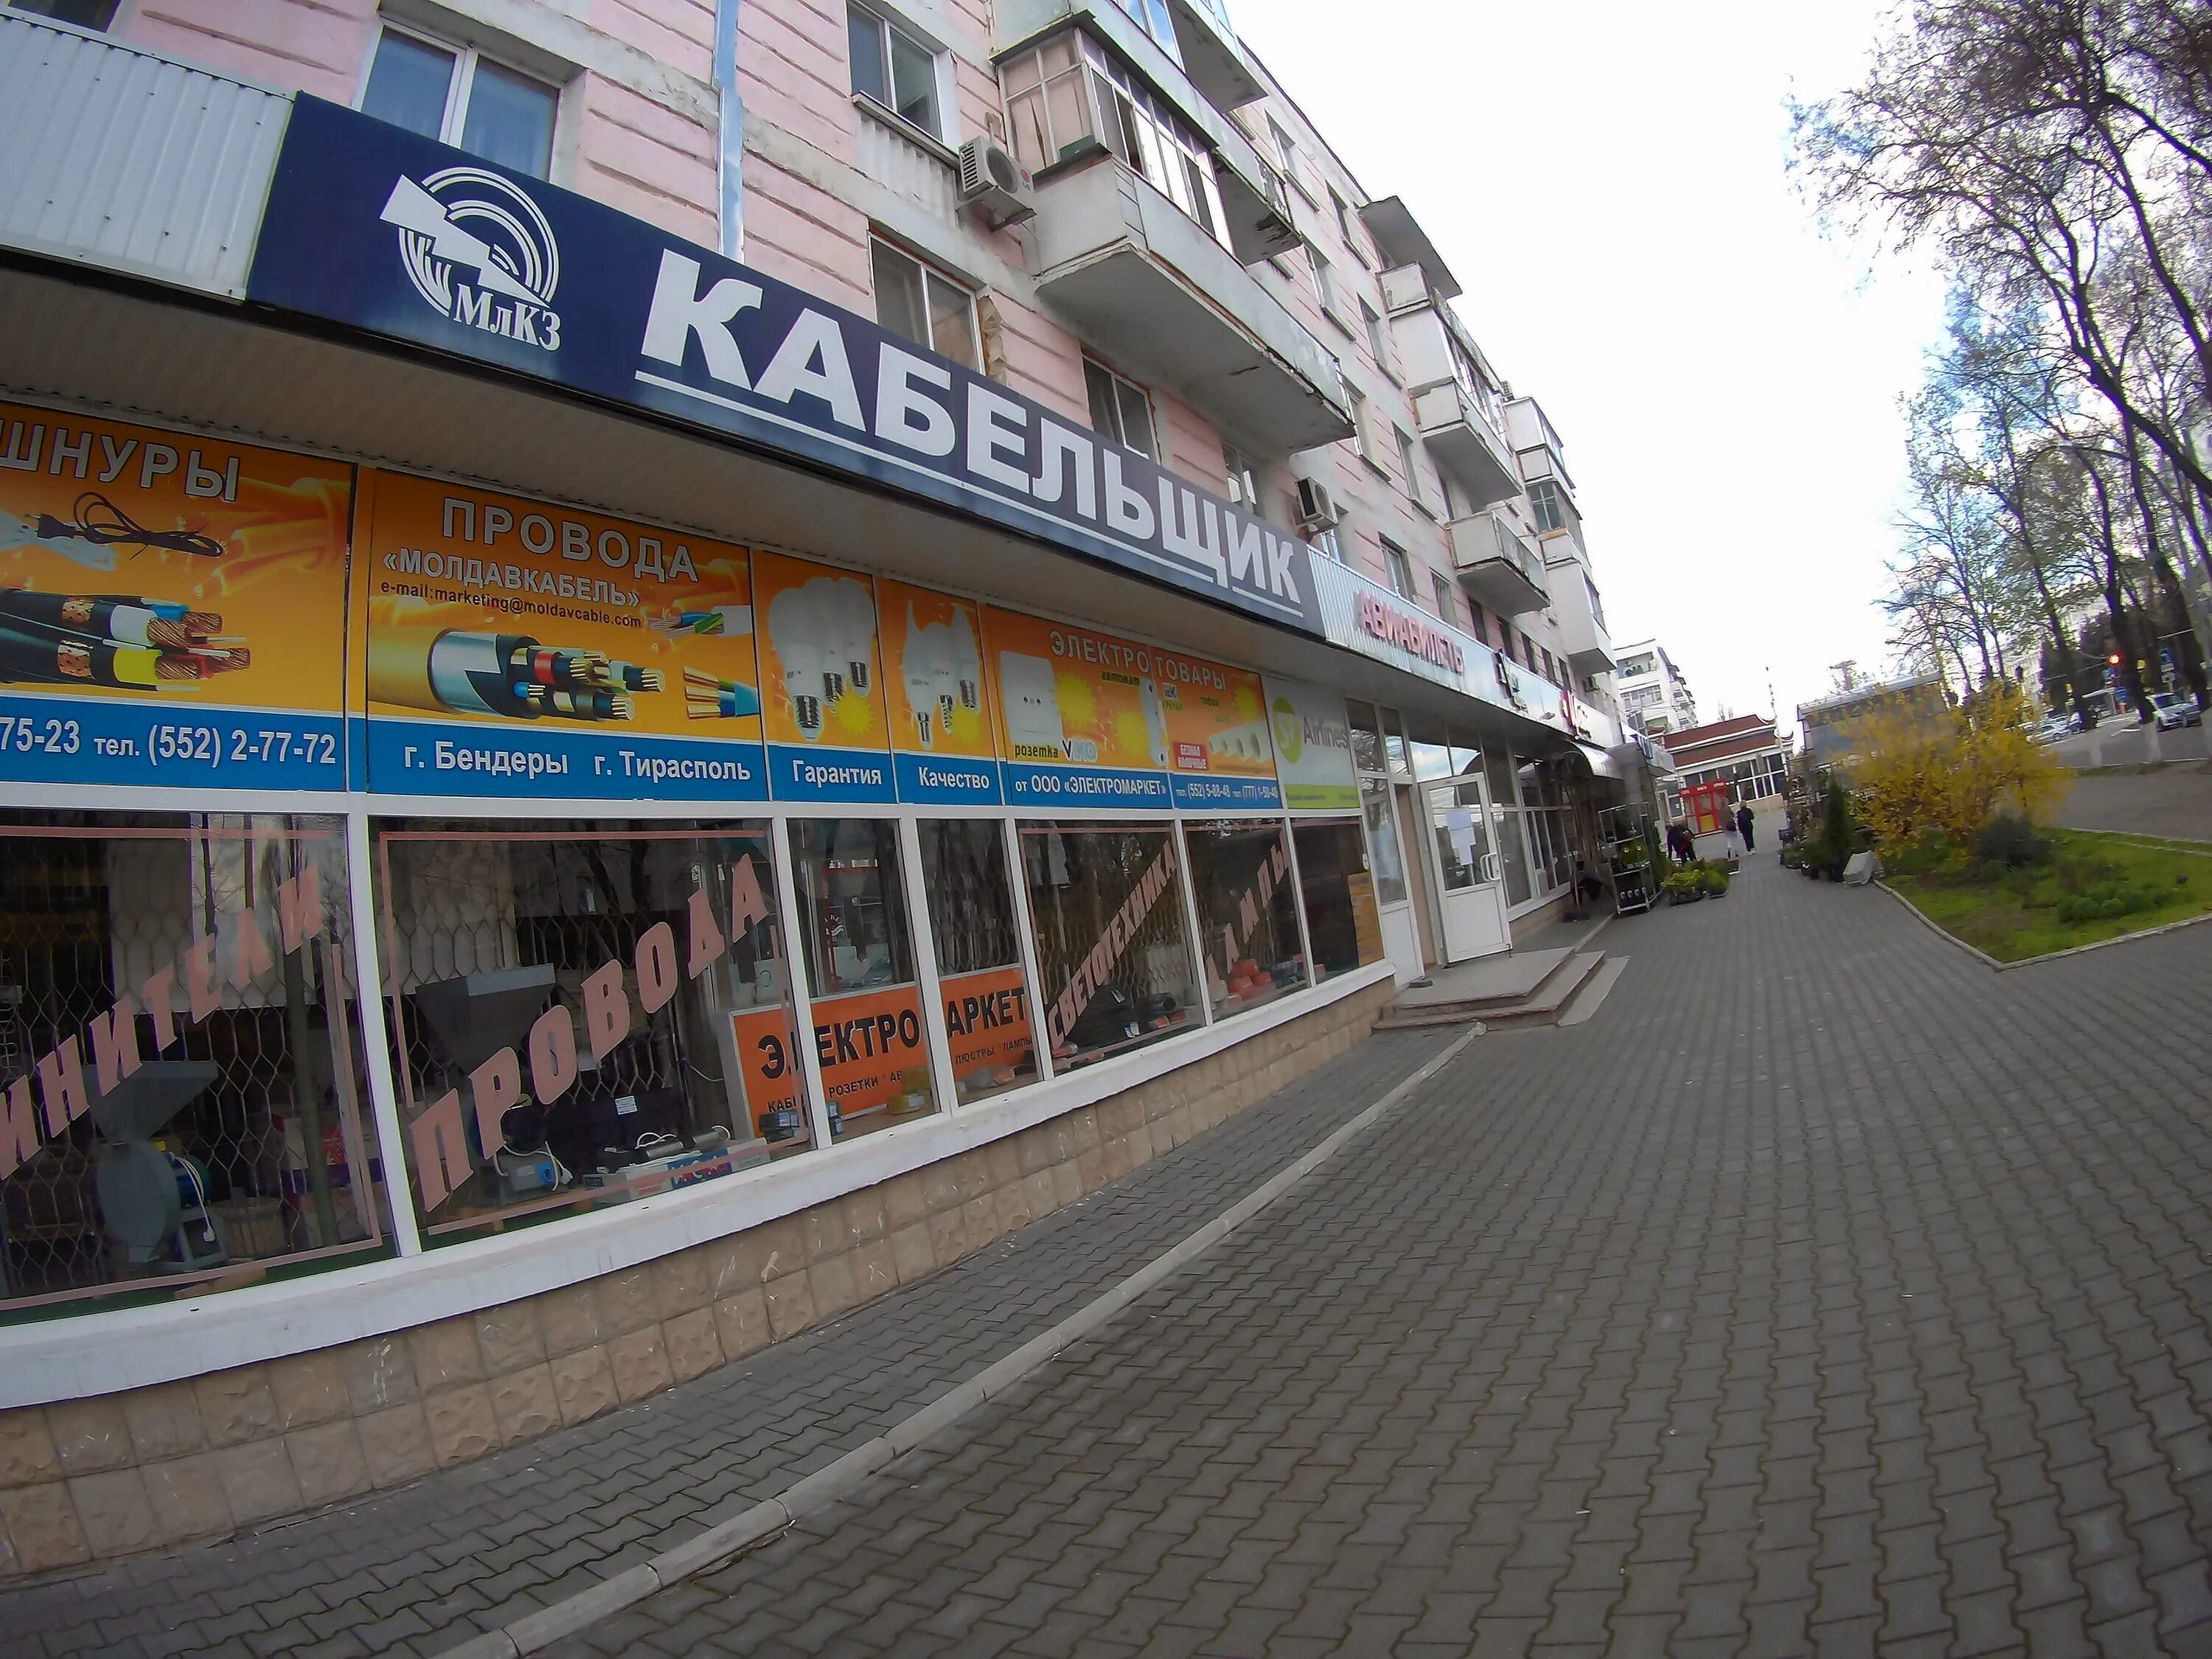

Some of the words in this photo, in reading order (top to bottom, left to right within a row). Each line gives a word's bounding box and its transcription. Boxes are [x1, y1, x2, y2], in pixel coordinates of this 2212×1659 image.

[640, 248, 1301, 605] КАБЕЛЬЩИК
[0, 419, 240, 502] ШНУРЫ
[442, 498, 700, 583] ПРОВОДА
[383, 548, 641, 608] «МОЛДАВКАБЕЛЬ»
[380, 581, 642, 628] e-mail:marketing@moldavcable.com
[94, 737, 141, 756] тел.
[148, 724, 221, 768] (552)
[231, 728, 336, 764] 2-77-72
[405, 746, 425, 768] г.
[435, 740, 568, 779] Бендеры
[594, 755, 613, 776] г.
[619, 751, 751, 783] Тирасполь
[793, 759, 883, 788] Гарантия
[918, 766, 990, 790] Качество
[1015, 781, 1027, 792] от
[1031, 774, 1061, 793] ООО
[1064, 776, 1167, 796] «ЭЛЕКТРОМАРКЕТ»
[408, 852, 768, 1213] ПРОВОДА
[828, 1077, 879, 1097] РОЗЕТКИ
